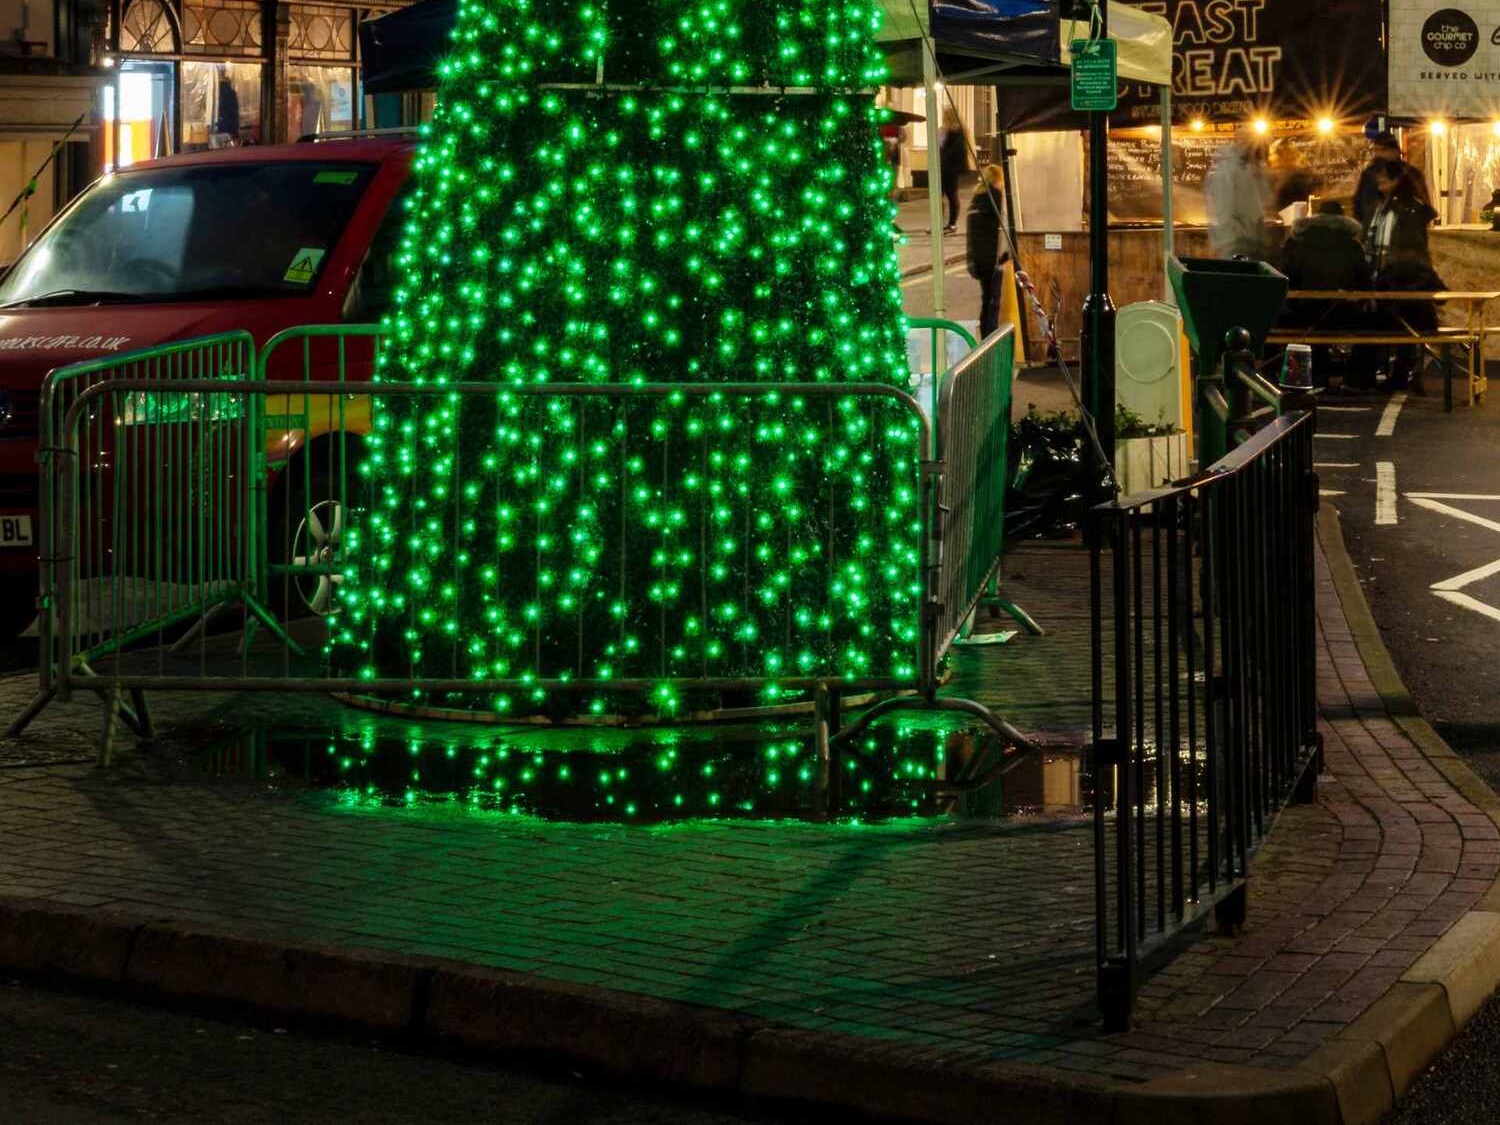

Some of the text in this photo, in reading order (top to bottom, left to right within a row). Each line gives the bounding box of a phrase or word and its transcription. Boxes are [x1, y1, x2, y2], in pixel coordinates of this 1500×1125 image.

[1441, 24, 1458, 32] the
[1427, 32, 1474, 42] GOURMET
[1434, 42, 1467, 50] chip co
